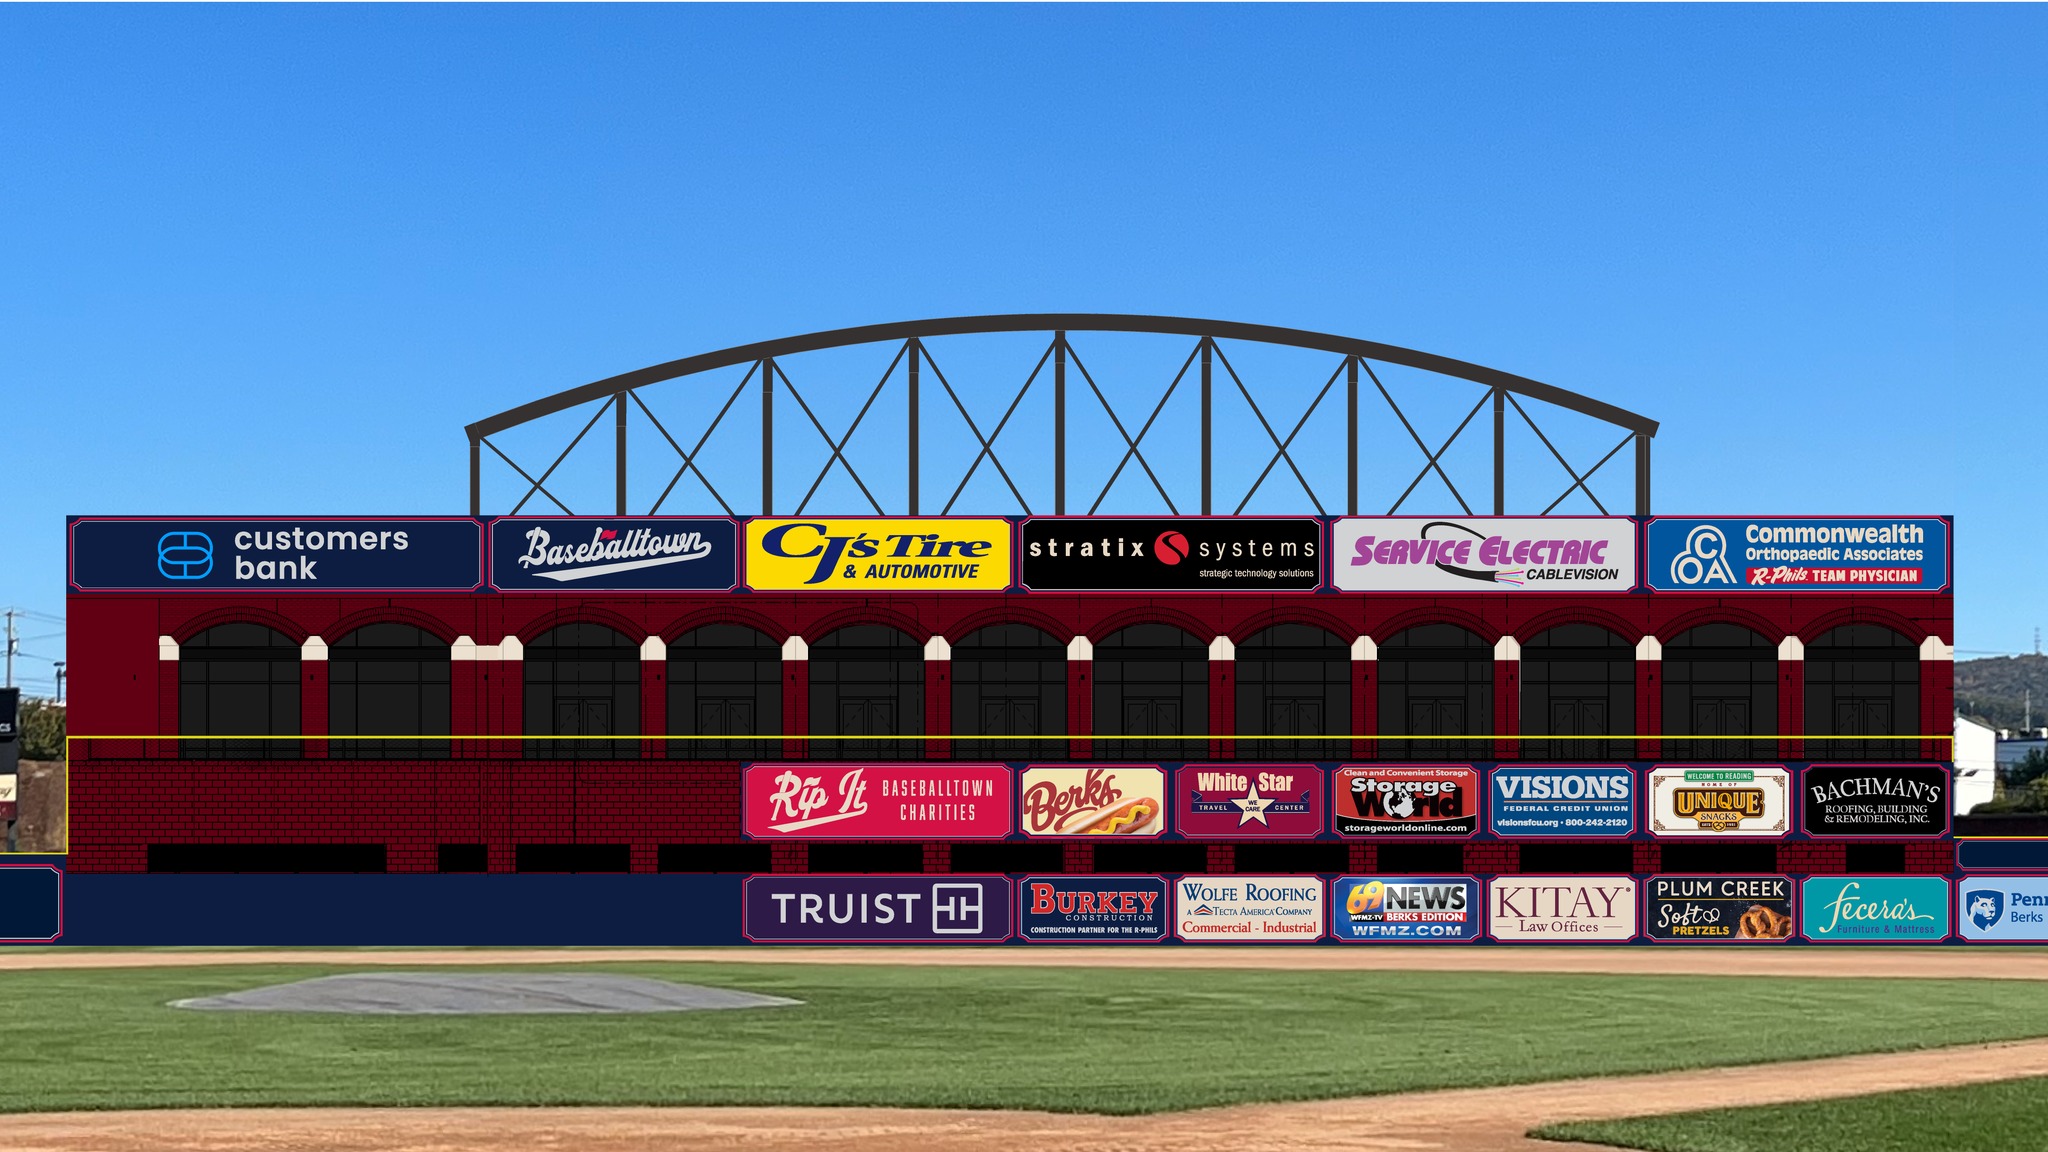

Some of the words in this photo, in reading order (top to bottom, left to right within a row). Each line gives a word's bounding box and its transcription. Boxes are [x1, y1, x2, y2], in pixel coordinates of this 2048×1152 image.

[234, 527, 409, 550] customers
[1745, 524, 1924, 544] Commonwealth
[518, 526, 712, 576] Baseballtown
[761, 523, 880, 584] CJ's
[886, 533, 993, 558] Tire
[1029, 538, 1145, 557] stratix
[1199, 539, 1315, 561] systems
[1350, 535, 1472, 566] SERVICE
[1478, 535, 1609, 566] ELECTRIC
[1745, 547, 1840, 562] Orthopaedic
[1843, 547, 1923, 561] Associates
[235, 555, 318, 579] bank
[843, 564, 856, 579] &
[864, 564, 980, 579] AUTOMOTIVE
[1199, 568, 1233, 579] strategic
[1234, 568, 1277, 579] technology
[1278, 568, 1314, 578] solutions
[1526, 568, 1619, 580] CABLEVISION
[1812, 569, 1846, 582] TEAM
[1850, 569, 1918, 582] PHYSICIAN
[1343, 769, 1368, 777] Clean
[1369, 769, 1385, 777] and
[1386, 769, 1434, 777] Convenient
[1435, 769, 1468, 778] Storage
[1687, 772, 1715, 780] WELCOME
[1716, 772, 1723, 780] TO
[1725, 772, 1752, 780] READING
[882, 779, 994, 797] BASEBALLTOWN
[1197, 772, 1247, 792] White
[1258, 772, 1294, 792] Star
[1351, 777, 1457, 797] Storage
[1496, 775, 1629, 799] VISIONS
[769, 770, 829, 821] Rip
[838, 768, 868, 814] It
[1023, 769, 1122, 832] Berks
[1677, 791, 1761, 814] UNIQUE
[1825, 805, 1876, 815] ROOFING,
[1878, 805, 1928, 814] BUILDING
[900, 804, 976, 821] CHARITIES
[1700, 812, 1737, 821] SNACKS
[1824, 814, 1835, 823] &
[1836, 814, 1907, 824] REMODELING,
[1909, 814, 1930, 823] INC.
[1344, 824, 1467, 834] storageworldonline.com
[1497, 818, 1559, 828] visionsfcu.org
[1565, 818, 1627, 827] 800-242-2120
[1182, 883, 1238, 901] WOLFE
[1245, 883, 1317, 901] ROOFING
[1657, 881, 1712, 896] PLUM
[1721, 881, 1784, 896] CREEK
[1030, 883, 1158, 915] BURKEY
[1346, 880, 1385, 915] 69
[1386, 886, 1466, 910] NEWS
[771, 893, 922, 924] TRUIST
[1213, 906, 1238, 916] TECTA
[1275, 906, 1313, 916] COMPANY
[1657, 903, 1703, 928] Soft
[1387, 912, 1418, 922] BERKS
[1421, 912, 1464, 922] EDITION
[2011, 911, 2044, 923] Berks
[1030, 926, 1076, 934] CONSTRUCTION
[1077, 926, 1105, 934] PARTNER
[1107, 926, 1119, 934] FOR
[1121, 926, 1132, 934] THE
[1134, 926, 1158, 934] R-PHILS
[1182, 921, 1251, 933] Commercial
[1263, 921, 1317, 933] Industrial
[1352, 926, 1462, 936] WFMZ.COM
[1519, 920, 1548, 932] Law
[1551, 920, 1599, 932] Offices
[1672, 926, 1730, 935] PRETZELS
[1837, 924, 1880, 934] Furniture
[1883, 925, 1891, 934] &
[1894, 924, 1935, 934] Mattress
